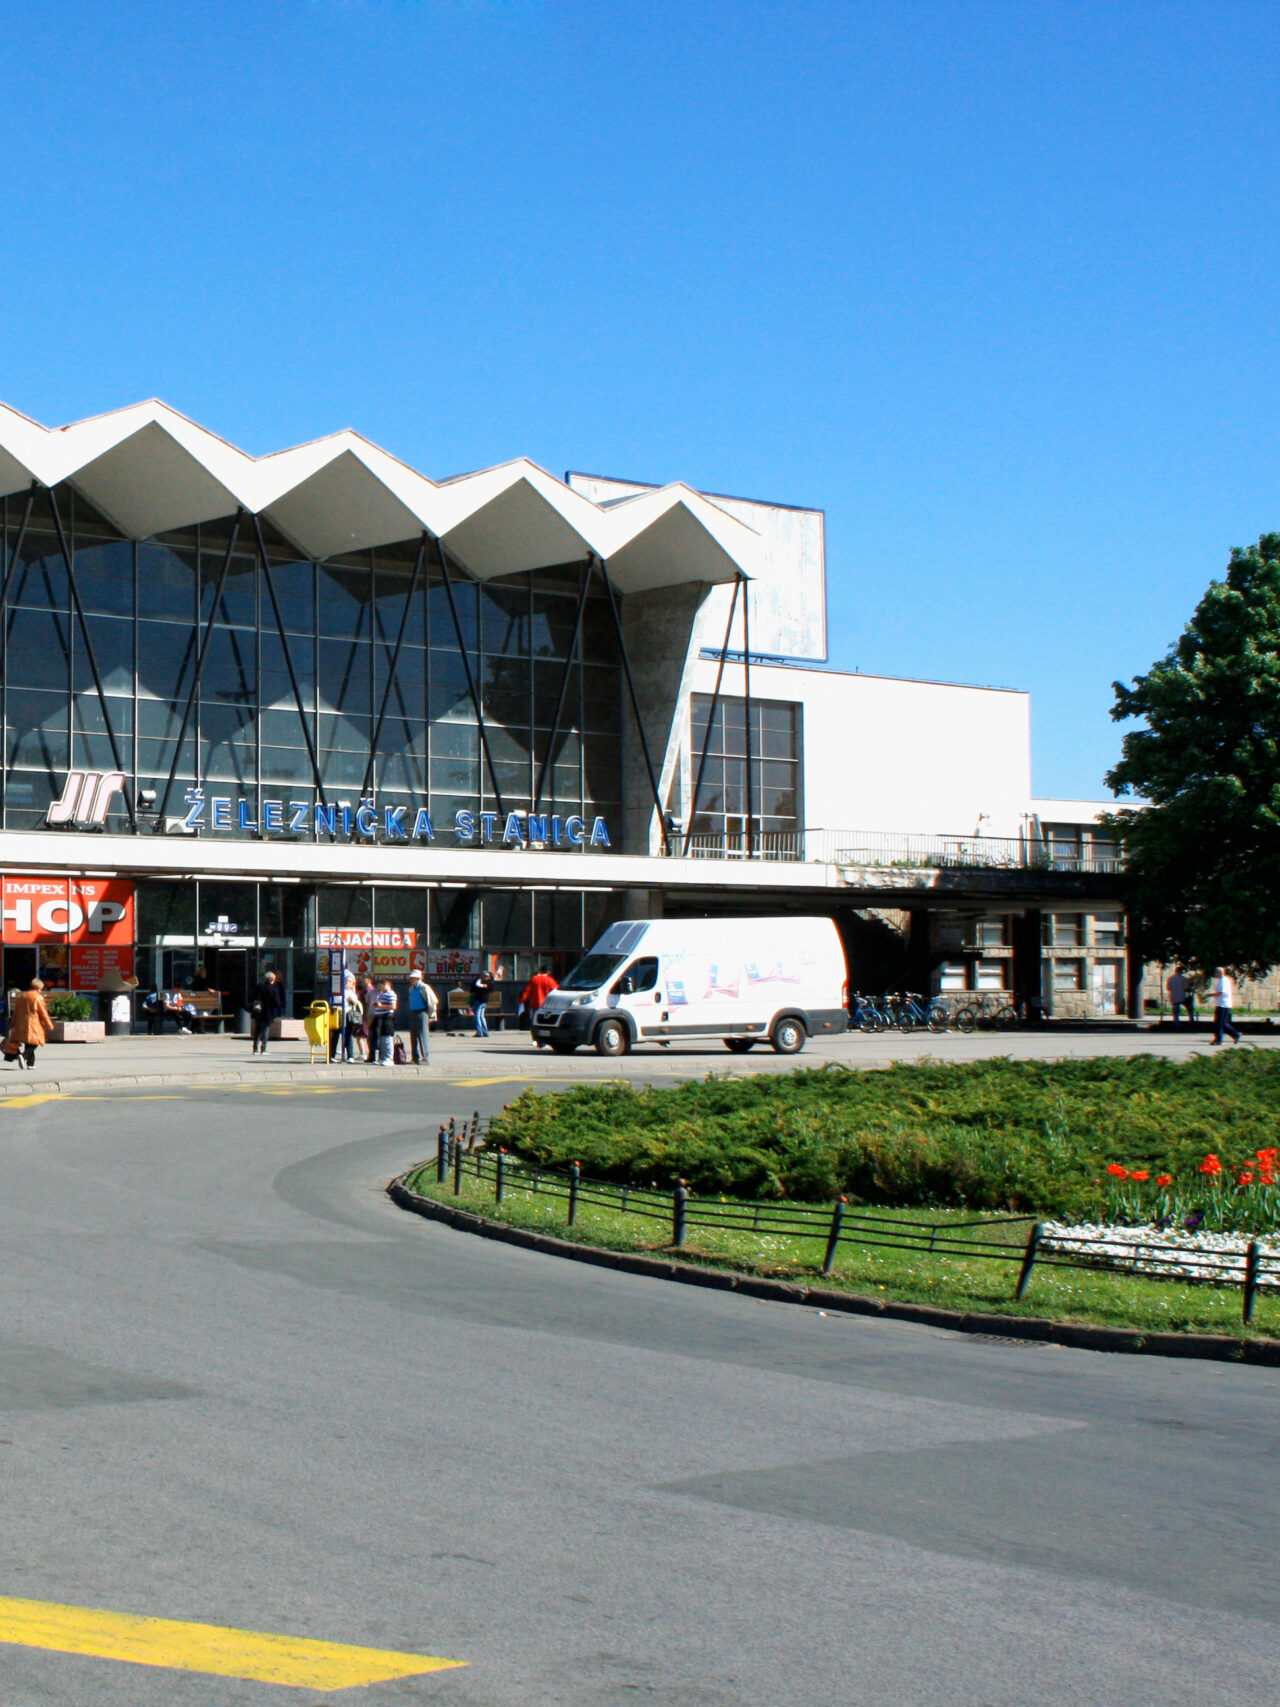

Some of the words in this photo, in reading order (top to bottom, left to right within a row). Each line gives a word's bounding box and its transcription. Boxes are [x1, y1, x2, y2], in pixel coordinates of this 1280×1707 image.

[184, 787, 435, 840] ŽELEZNIČKA
[454, 809, 612, 847] STANICA
[5, 883, 66, 895] IMPEX
[71, 885, 96, 896] NS
[373, 956, 408, 967] LOTO
[436, 960, 471, 973] BINGO
